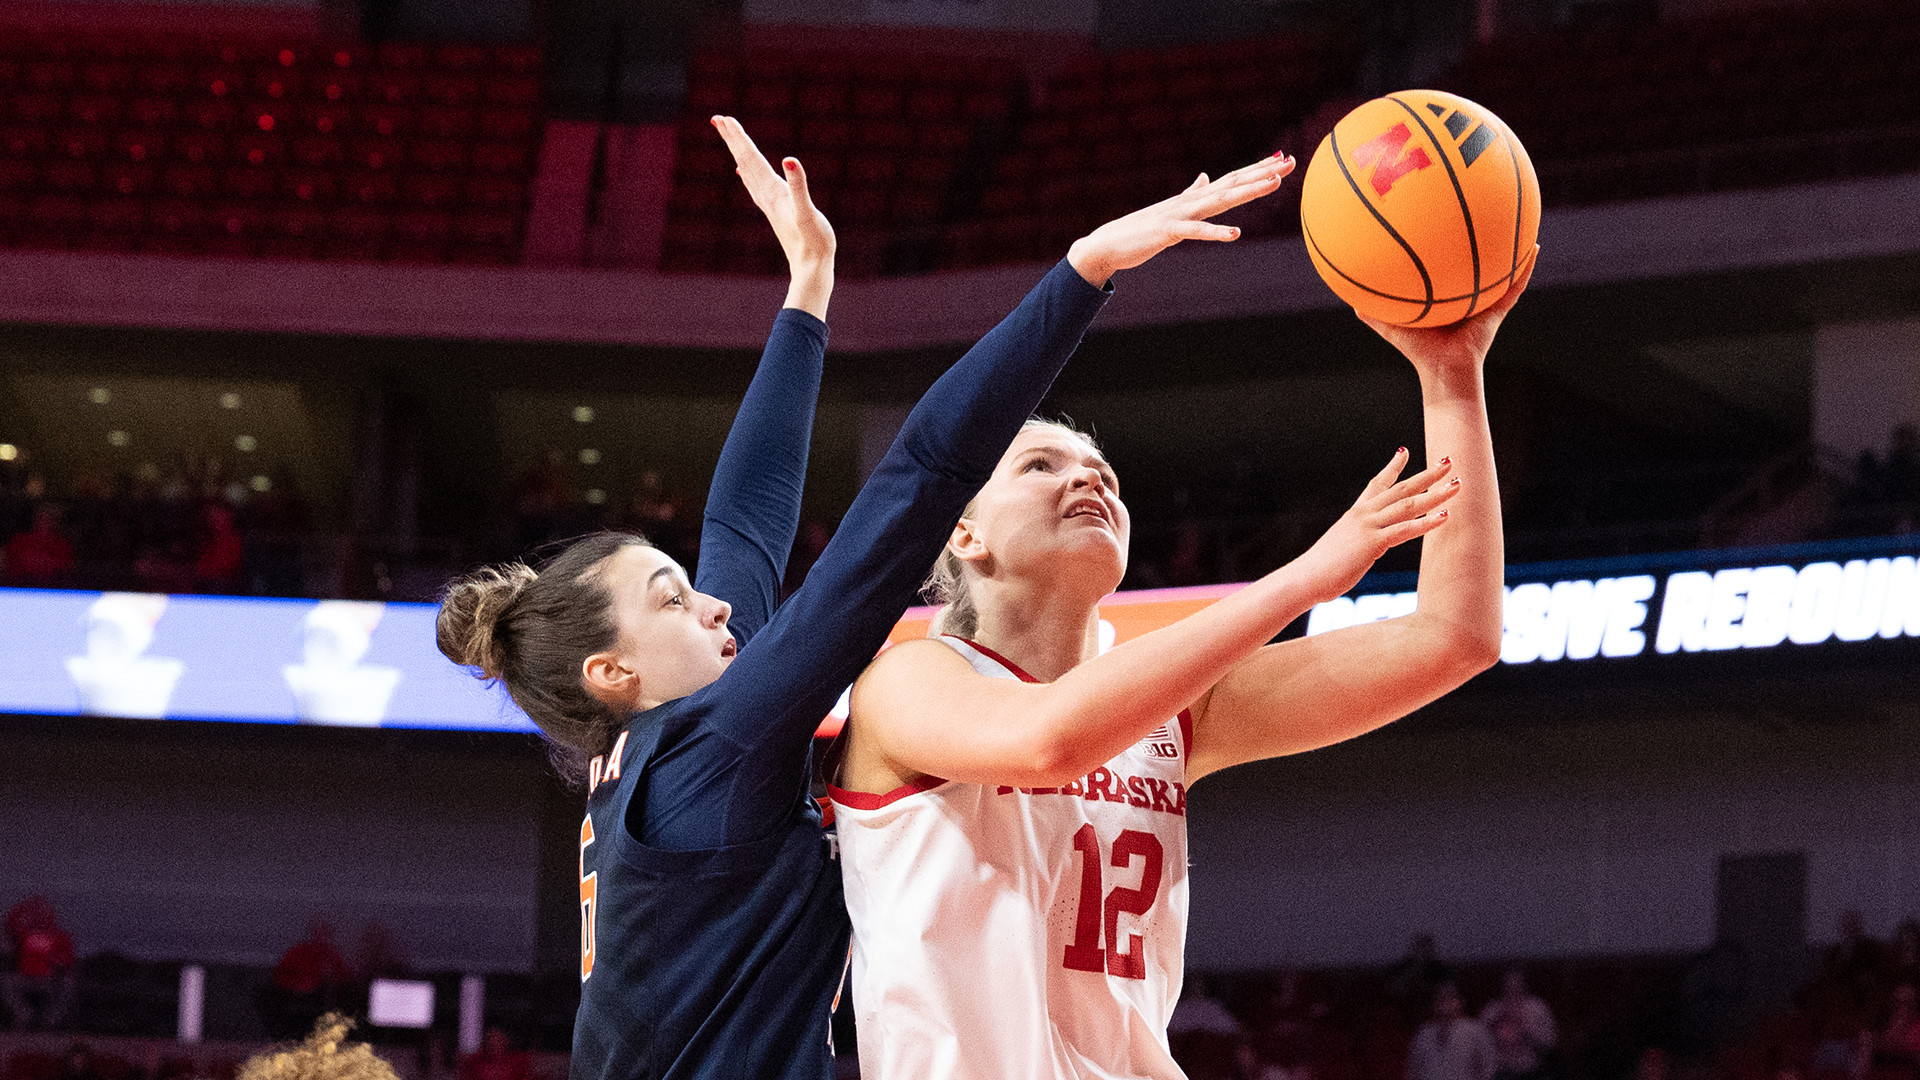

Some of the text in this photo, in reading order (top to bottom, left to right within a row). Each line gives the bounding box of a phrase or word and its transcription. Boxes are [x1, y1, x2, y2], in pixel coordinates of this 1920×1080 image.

[1352, 121, 1433, 198] N
[997, 765, 1187, 817] RASKA
[1062, 822, 1164, 980] 12
